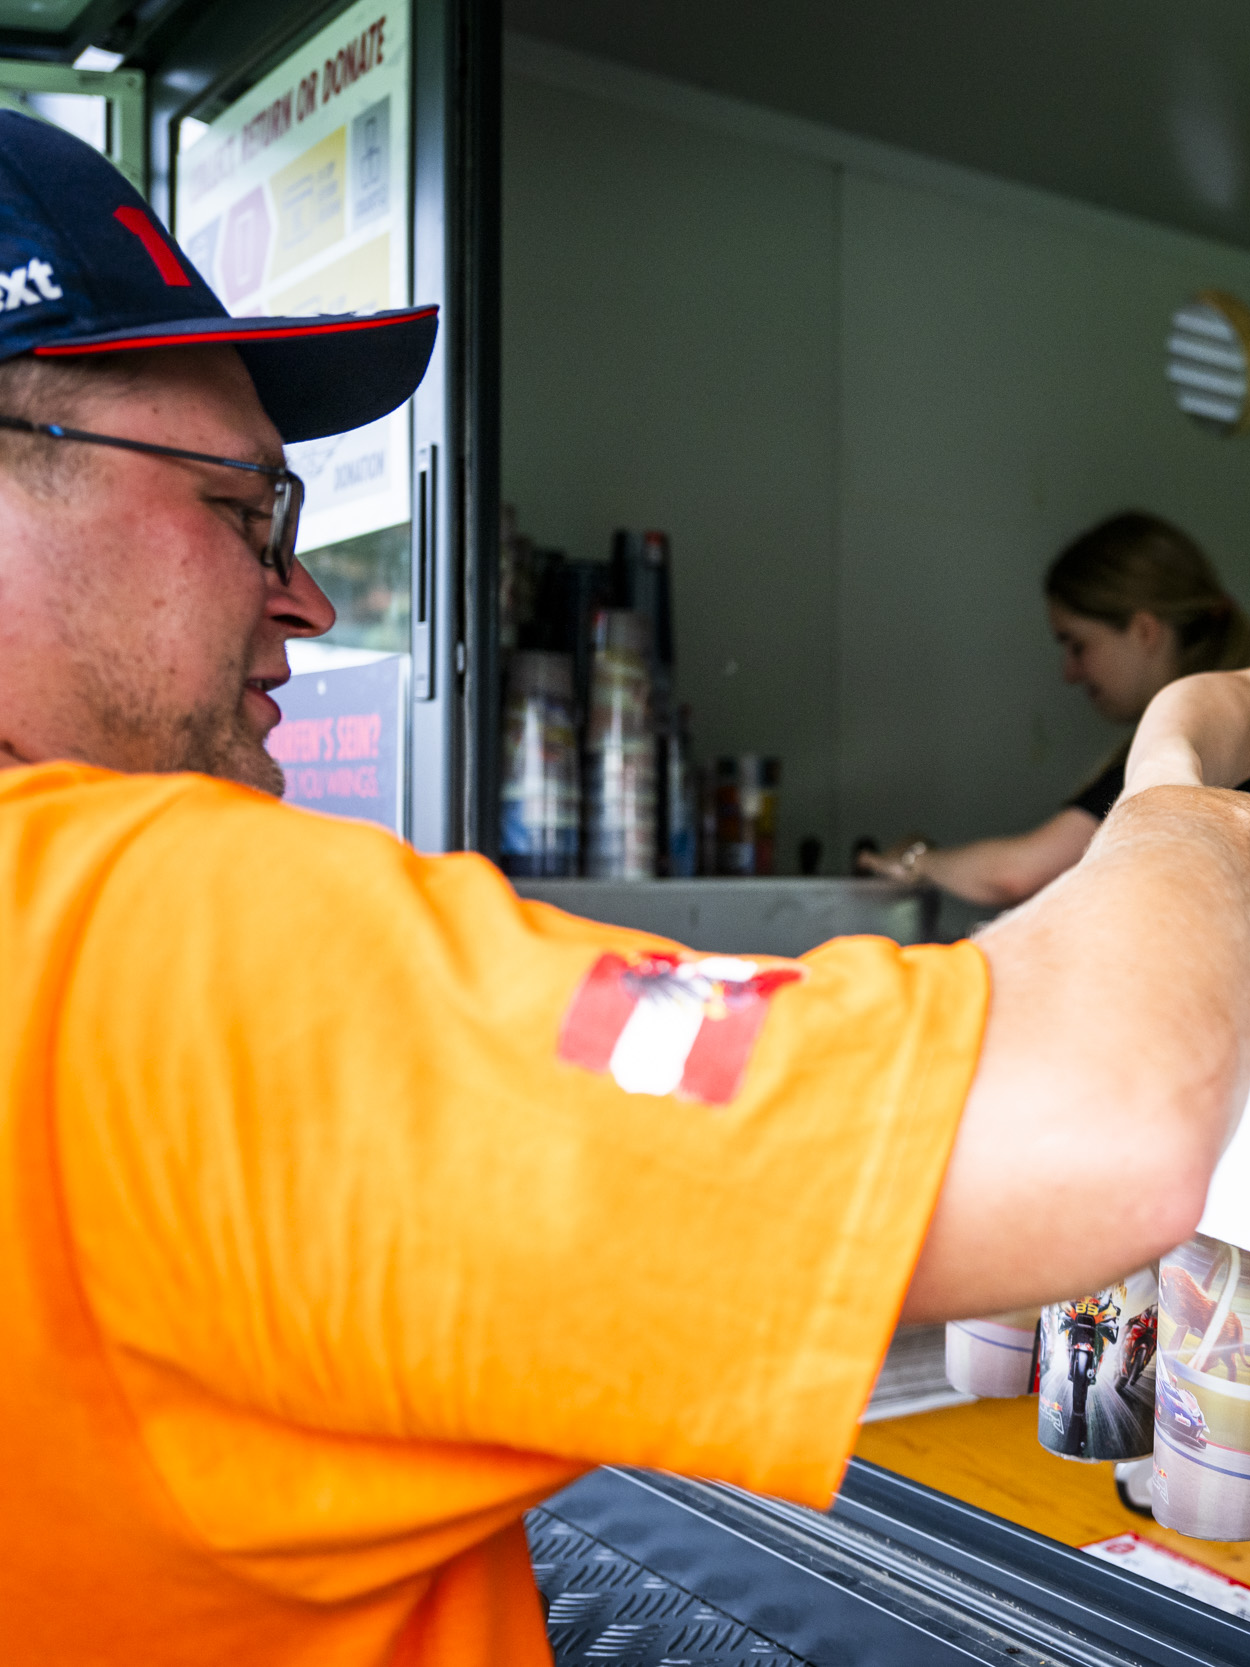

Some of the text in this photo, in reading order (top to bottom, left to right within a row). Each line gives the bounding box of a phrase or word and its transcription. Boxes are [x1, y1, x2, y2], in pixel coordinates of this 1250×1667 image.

[297, 68, 318, 123] OR
[321, 14, 387, 105] DONATE
[0, 257, 63, 312] xt
